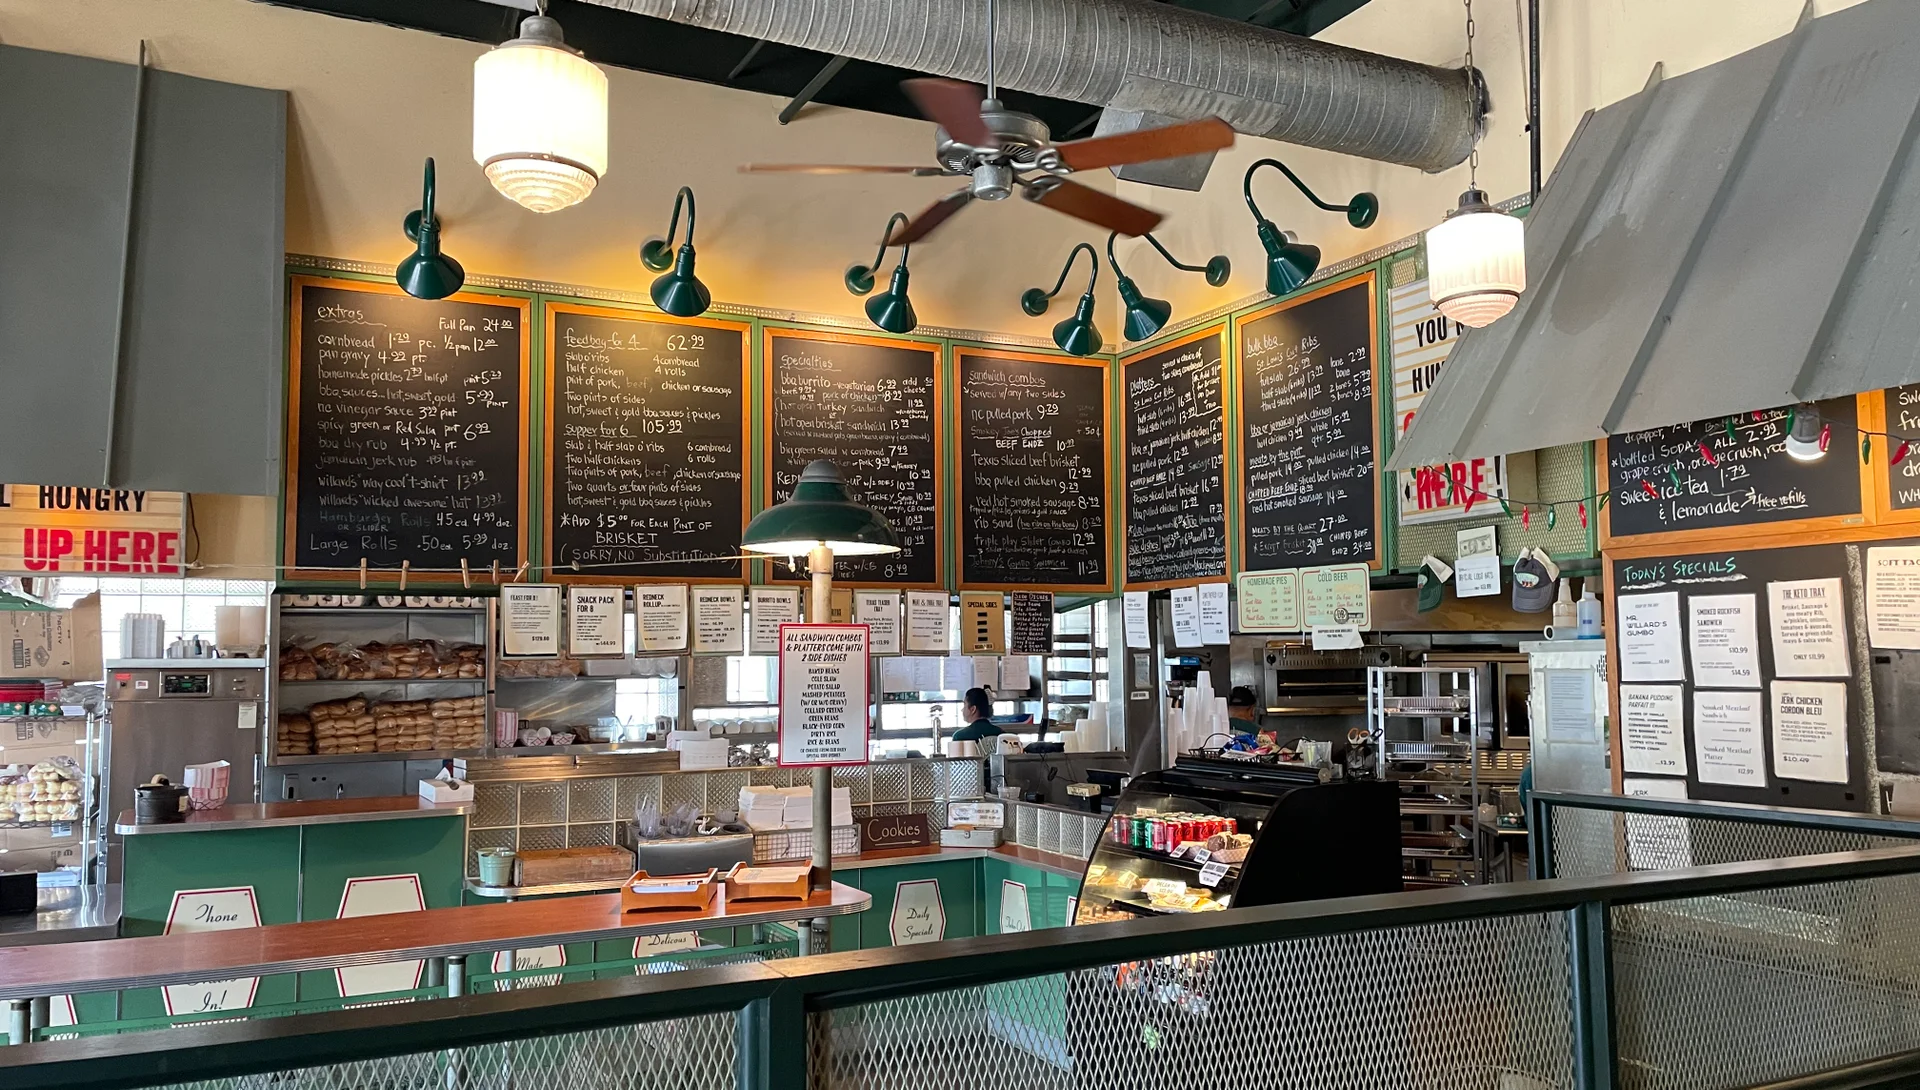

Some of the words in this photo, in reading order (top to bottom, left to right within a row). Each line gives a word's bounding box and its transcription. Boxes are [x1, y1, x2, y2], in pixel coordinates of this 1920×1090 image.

[318, 305, 364, 320] extras
[439, 317, 456, 331] Full
[459, 318, 476, 332] Pan
[1416, 316, 1447, 347] YOU
[318, 334, 375, 349] cornbread
[1247, 340, 1261, 352] bulk
[1302, 336, 1318, 352] Ribs
[341, 351, 370, 368] gravy
[566, 361, 586, 373] half
[590, 364, 624, 376] chicken
[318, 367, 370, 379] homemade
[371, 368, 403, 384] pickles
[799, 375, 831, 388] burrito
[903, 378, 917, 386] add
[1009, 374, 1046, 385] combos
[565, 391, 581, 402] two
[610, 393, 621, 403] of
[1026, 389, 1040, 398] two
[1042, 390, 1066, 399] sides
[336, 402, 381, 419] vinegar
[384, 404, 414, 417] sauce
[622, 407, 640, 421] gold
[817, 402, 847, 413] turkey
[318, 418, 343, 435] spicy
[350, 421, 379, 432] green
[396, 420, 412, 434] Red
[600, 423, 617, 435] for
[1020, 427, 1052, 438] Chopped
[1311, 421, 1328, 432] whole
[367, 440, 387, 450] rub
[595, 440, 614, 451] half
[616, 442, 634, 452] slab
[996, 440, 1017, 448] BEEF
[1714, 438, 1736, 448] ALL
[398, 456, 417, 467] rub
[565, 452, 582, 464] two
[603, 454, 641, 465] chickens
[696, 454, 716, 463] rolls
[971, 450, 999, 466] texas
[1001, 453, 1027, 466] sliced
[1029, 453, 1046, 467] beef
[1050, 455, 1079, 467] brisket
[1327, 450, 1350, 464] chicken
[645, 465, 670, 478] beef
[1620, 467, 1649, 486] grape
[994, 472, 1020, 488] pulled
[1024, 474, 1056, 487] chicken
[1683, 478, 1708, 495] tea
[565, 480, 582, 492] two
[587, 482, 617, 494] quarts
[39, 485, 145, 512] HUNGRY
[865, 492, 894, 501] TURKEY
[1010, 497, 1040, 507] smoked
[1043, 499, 1076, 512] sausage
[1672, 497, 1740, 522] lemonade
[338, 523, 349, 531] OR
[356, 523, 388, 532] SLIDER
[630, 519, 645, 528] FOR
[649, 518, 669, 528] EACH
[673, 518, 695, 530] PINT
[698, 521, 712, 530] OF
[992, 515, 1013, 529] sand
[310, 534, 349, 555] Large
[361, 535, 398, 550] Rolls
[596, 532, 658, 544] BRISKET
[24, 529, 73, 571] UP
[84, 531, 178, 573] HERE
[1672, 557, 1736, 576] SPECIALS
[1275, 576, 1288, 585] PIES
[1318, 573, 1332, 582] COLD
[1334, 572, 1348, 581] BEER
[577, 596, 596, 604] SNACK
[786, 633, 798, 642] ALL
[800, 633, 834, 642] SANDWICH
[836, 633, 862, 642] COMBOS
[793, 644, 823, 652] PLATTERS
[824, 644, 843, 652] COME
[845, 644, 863, 652] WITH
[1780, 697, 1795, 705] JERK
[1798, 698, 1822, 706] CHICKEN
[1780, 706, 1804, 714] CORDON
[1806, 706, 1822, 715] BLEU
[867, 818, 920, 842] Cookies
[906, 907, 929, 921] Daily
[902, 926, 933, 939] Specials
